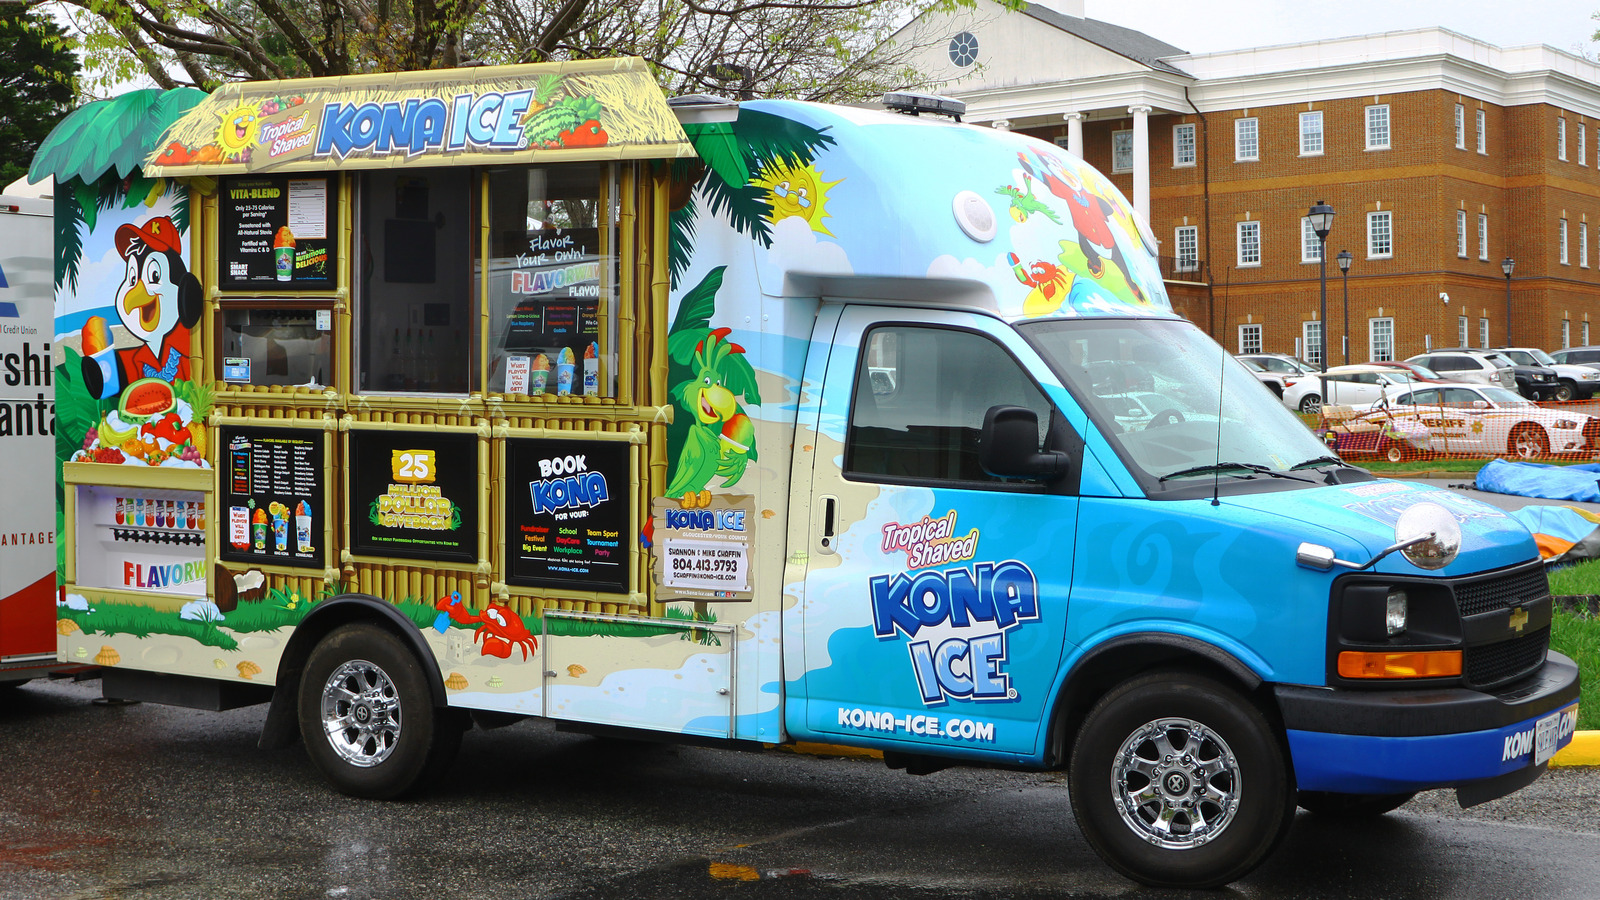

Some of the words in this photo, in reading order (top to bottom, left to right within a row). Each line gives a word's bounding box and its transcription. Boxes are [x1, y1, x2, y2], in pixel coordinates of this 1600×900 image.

[261, 112, 308, 142] Tropical
[315, 97, 448, 160] KONA
[447, 88, 536, 155] ICE
[270, 127, 315, 156] Shaved
[152, 222, 160, 235] K
[295, 248, 326, 261] NUTRITIOUS
[295, 254, 328, 269] DELICIOUS
[3, 324, 19, 334] Credit
[20, 325, 38, 335] Union
[0, 342, 52, 386] shi
[399, 453, 429, 479] 25
[538, 455, 588, 477] BOOK
[388, 484, 442, 498] MILLION
[529, 471, 609, 515] KONA
[379, 494, 452, 516] DOLLAR
[384, 513, 446, 530] GIVEBACK
[569, 510, 589, 519] YOUR:
[665, 509, 715, 531] KONA
[715, 509, 746, 531] ICE
[520, 525, 550, 533] Fundraiser
[559, 527, 578, 535] School
[602, 530, 619, 538] Sport
[883, 511, 956, 553] Tropical
[1, 531, 54, 546] ANTAGE
[524, 534, 545, 542] Festival
[556, 536, 581, 545] DayCare
[586, 538, 619, 547] Tournament
[522, 543, 531, 553] Big
[532, 544, 548, 552] Event
[553, 546, 583, 555] Workplace
[594, 548, 610, 557] Party
[668, 547, 696, 556] SHANNON
[702, 549, 715, 557] MIKE
[717, 549, 741, 558] CHAFFIN
[909, 530, 977, 569] Shaved
[672, 558, 737, 572] 804.413.9793
[123, 560, 207, 589] FLAVORW
[868, 559, 1039, 641] KONA
[907, 631, 1010, 706] ICE
[837, 706, 995, 741] KONA-ICE.COM
